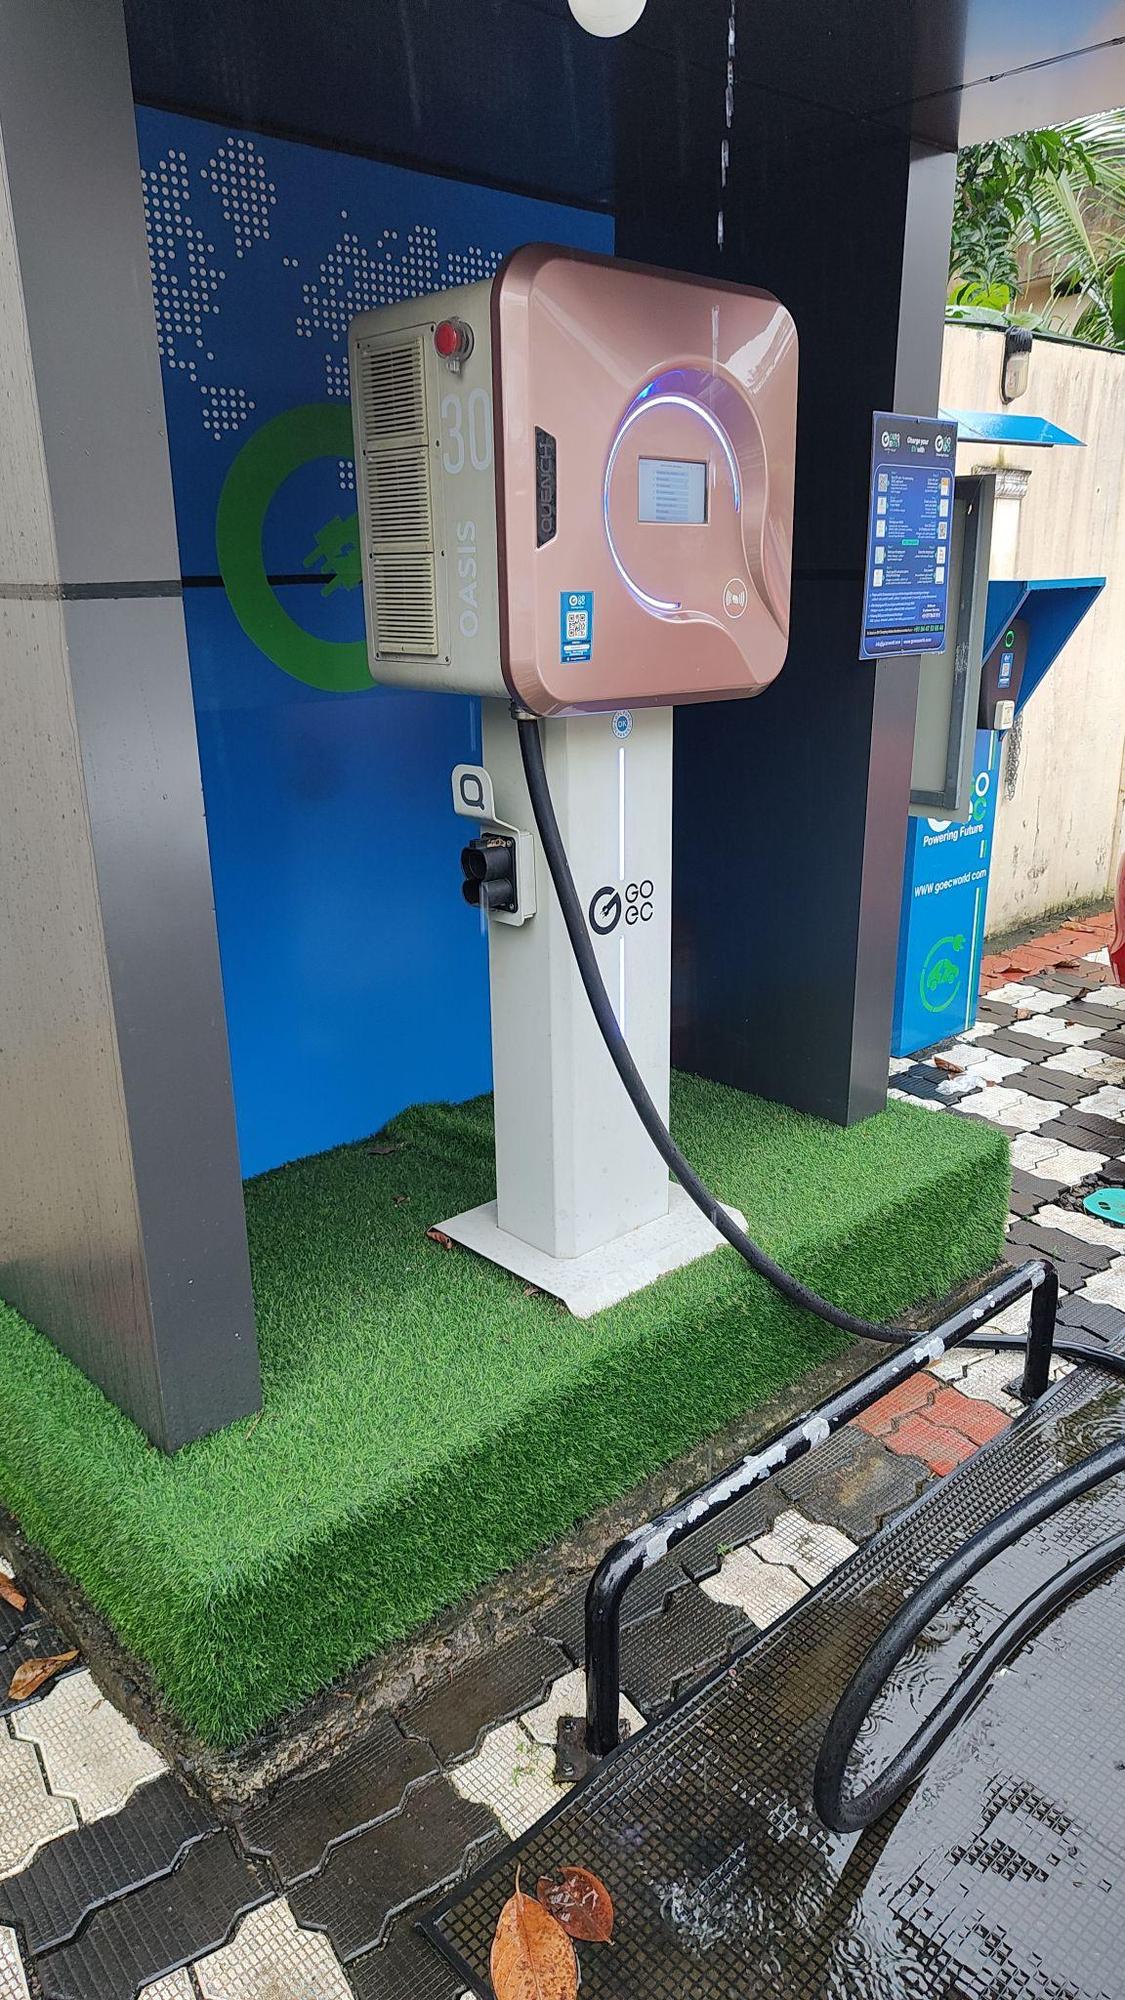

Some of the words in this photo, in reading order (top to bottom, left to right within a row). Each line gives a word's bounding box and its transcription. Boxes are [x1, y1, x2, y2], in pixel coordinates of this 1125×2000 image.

[441, 388, 493, 474] 30
[539, 438, 553, 532] QUENCH
[457, 520, 479, 638] OASIS
[922, 830, 959, 847] Powering
[959, 823, 984, 838] Future
[625, 880, 654, 904] GO
